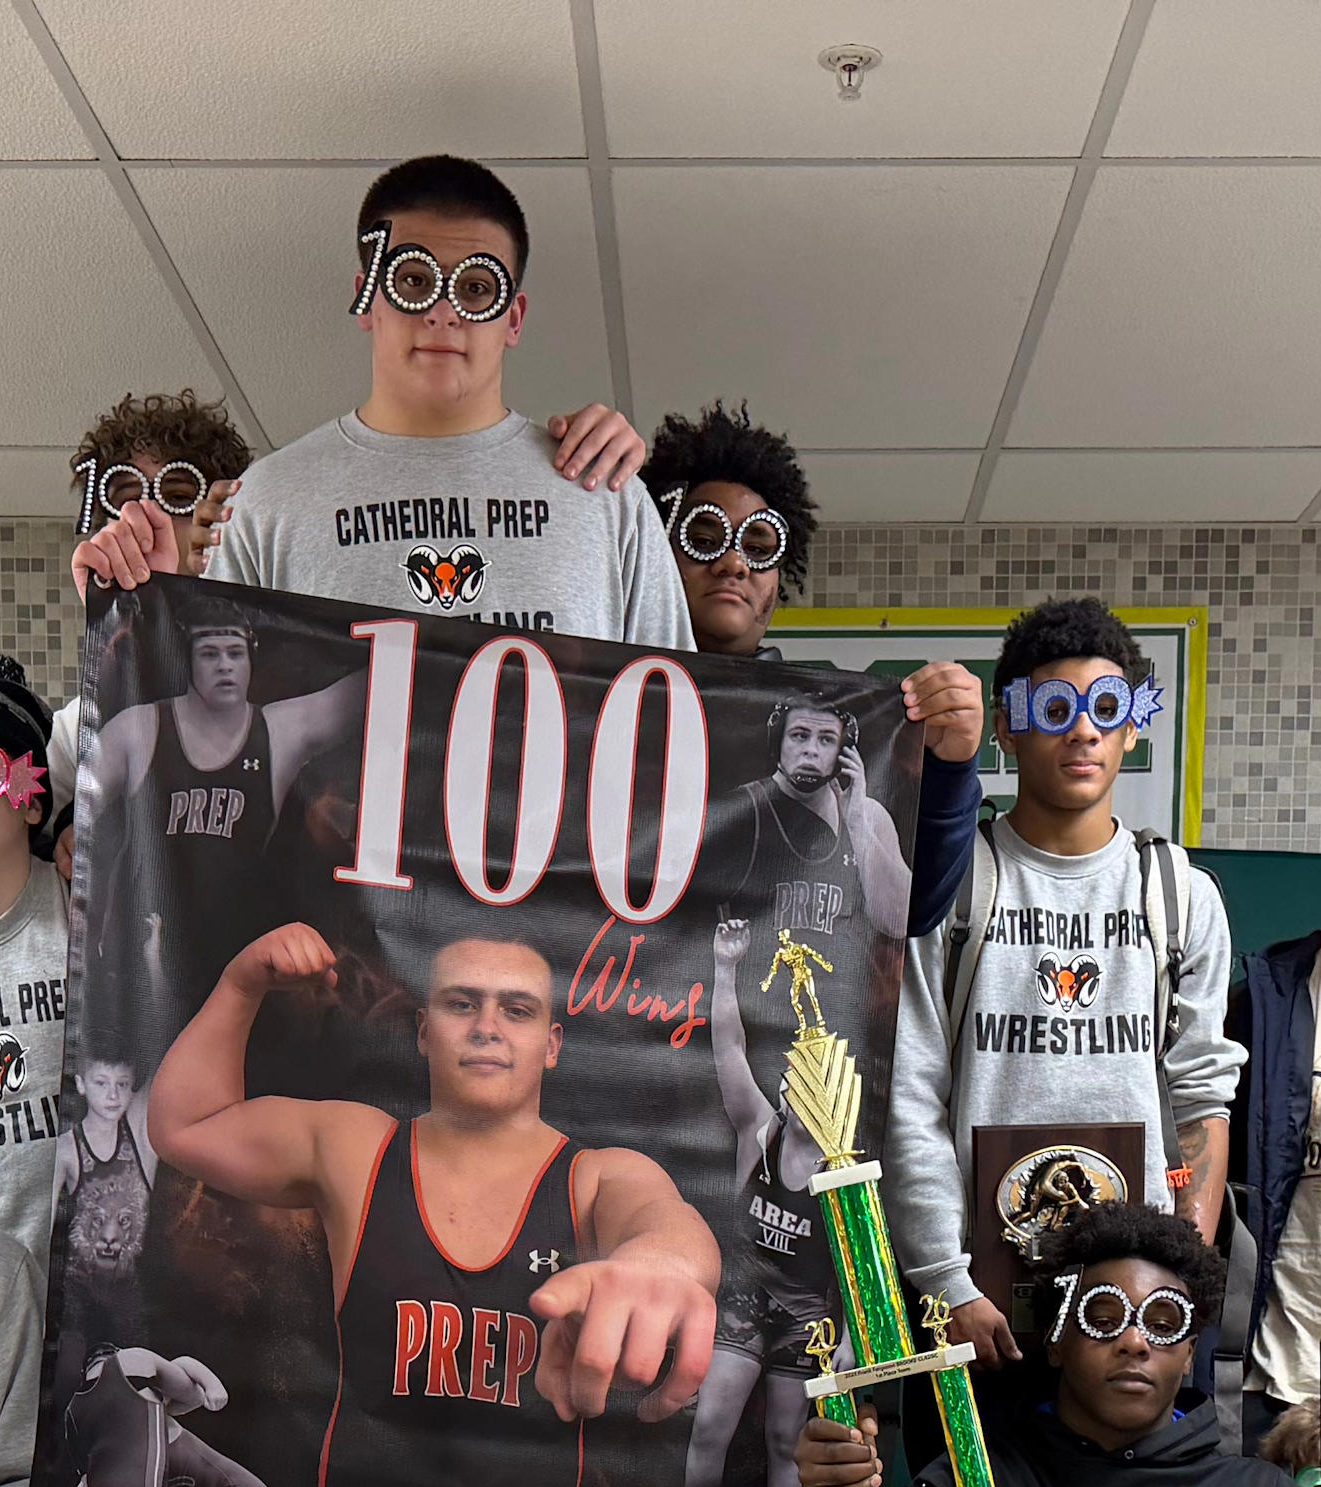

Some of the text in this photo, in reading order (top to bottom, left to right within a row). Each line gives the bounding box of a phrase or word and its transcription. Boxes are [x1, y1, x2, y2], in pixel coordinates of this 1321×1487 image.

[335, 497, 549, 546] CATHEDRAL PREP
[333, 618, 709, 924] 100
[166, 787, 245, 838] PREP
[773, 881, 843, 934] PREP
[18, 977, 67, 1025] PRE
[567, 915, 707, 1048] Wins
[975, 1012, 1151, 1055] WRESTLING
[749, 1195, 812, 1237] AREA
[756, 1222, 797, 1256] VIII
[392, 1300, 538, 1407] PREP
